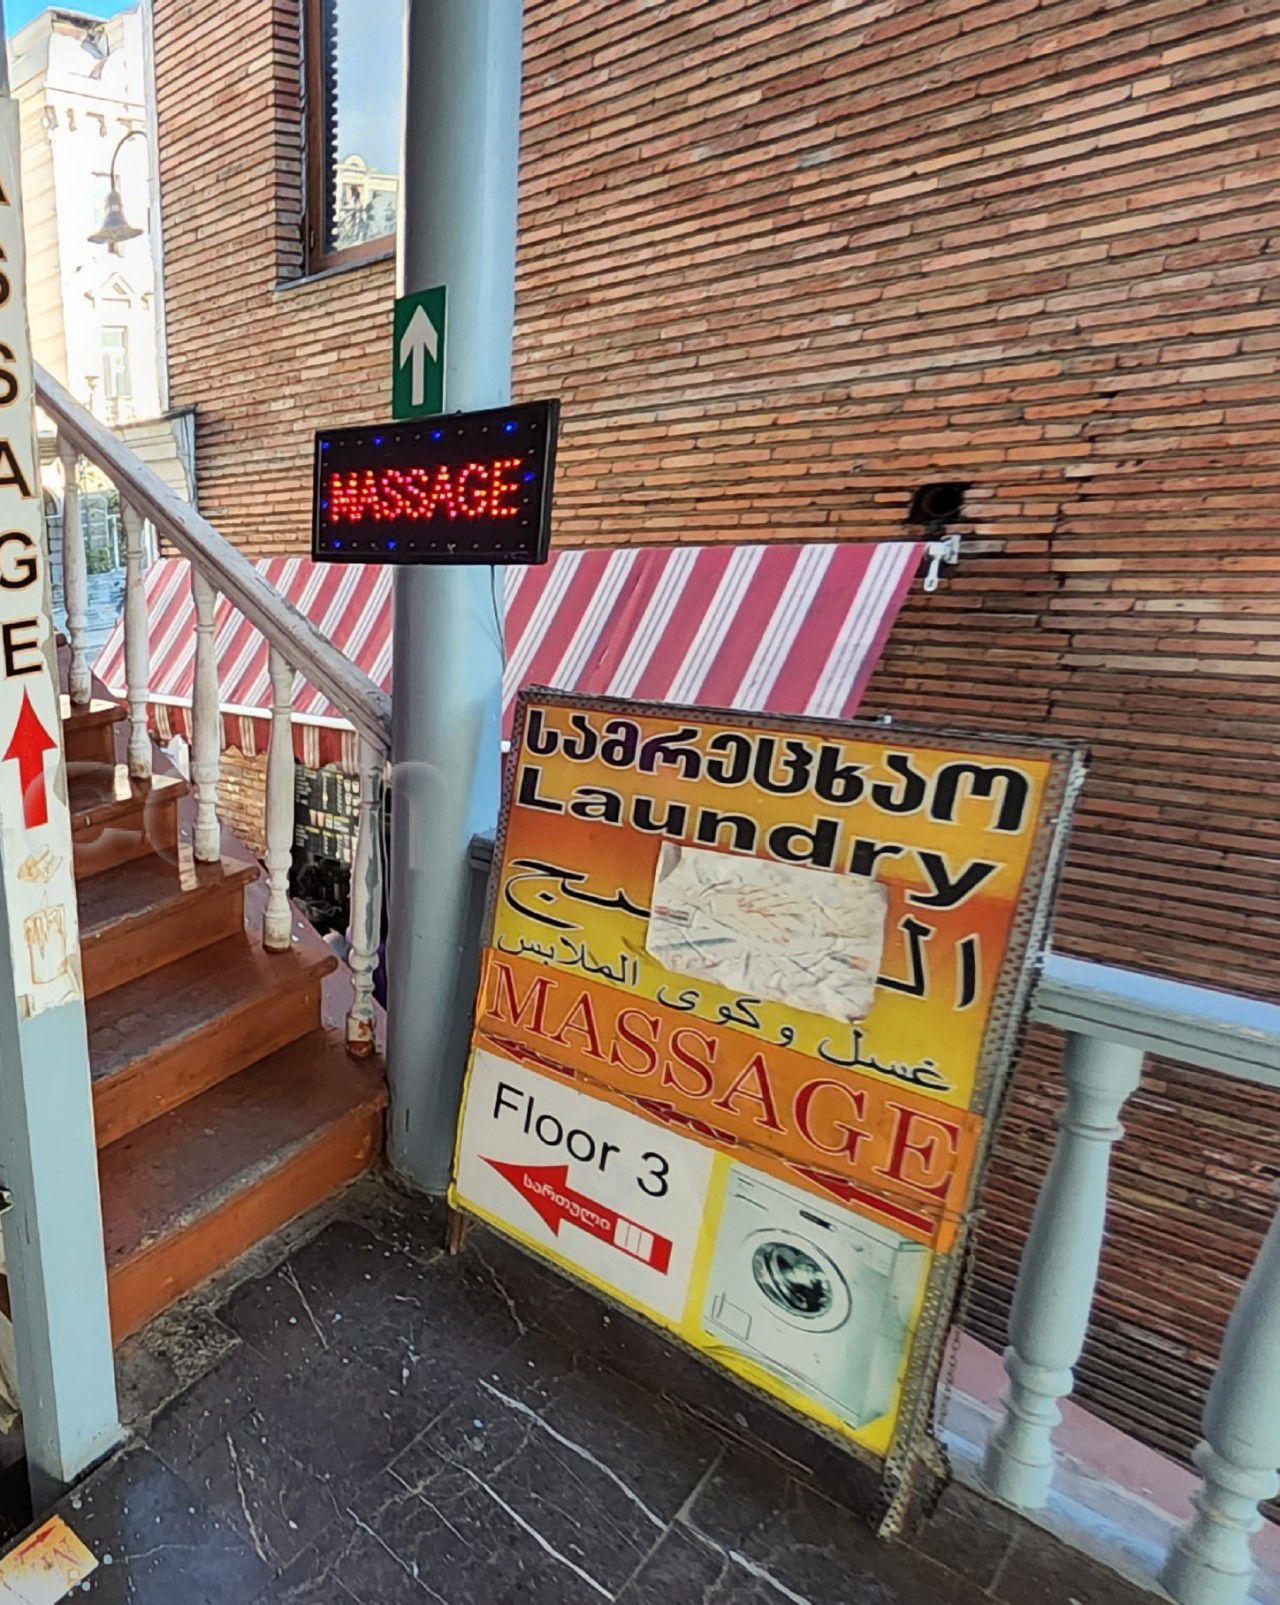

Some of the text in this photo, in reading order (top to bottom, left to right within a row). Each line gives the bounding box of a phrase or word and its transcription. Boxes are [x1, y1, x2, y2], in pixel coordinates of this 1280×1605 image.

[330, 458, 522, 523] MASSAGE
[526, 709, 1028, 833] სამრეცხაო
[519, 766, 999, 907] Laundry
[497, 934, 638, 986] الملابس
[777, 1025, 795, 1047] و
[816, 1028, 951, 1092] غسل
[488, 963, 960, 1200] MASSAGE
[493, 1081, 670, 1198] Floor 3
[522, 1173, 612, 1231] სართული
